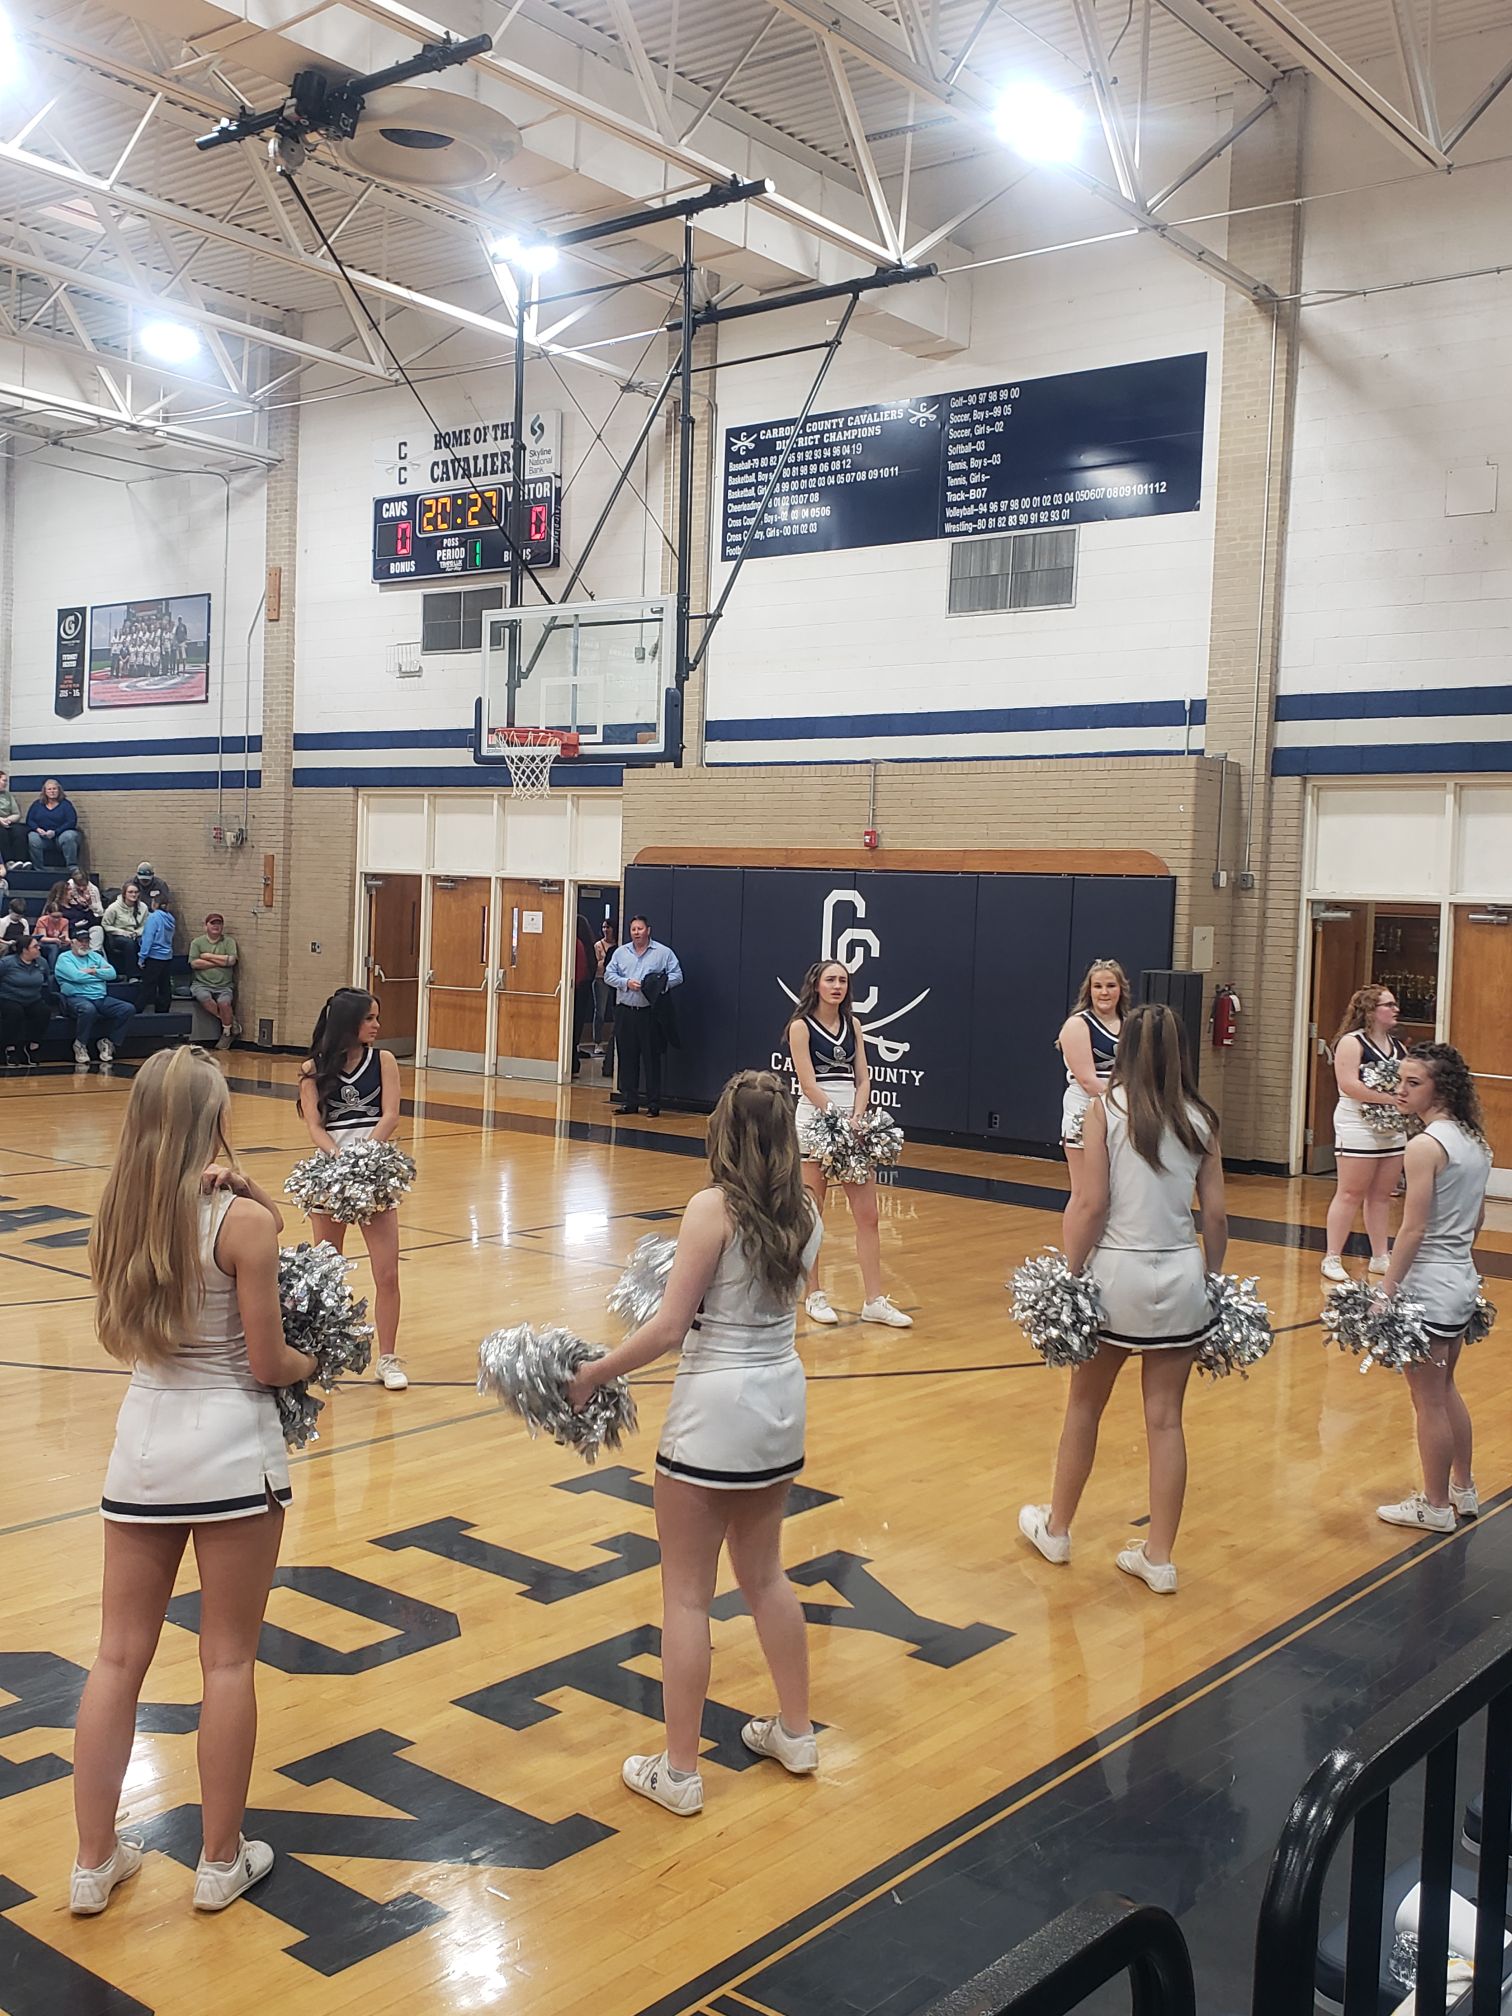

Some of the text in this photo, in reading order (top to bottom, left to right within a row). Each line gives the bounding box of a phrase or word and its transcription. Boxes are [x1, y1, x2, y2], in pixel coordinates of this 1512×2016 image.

[978, 392, 987, 404] 97
[999, 389, 1009, 400] 99
[1010, 387, 1020, 399] 00
[1003, 404, 1012, 415] 05
[760, 408, 904, 439] CARRO COUNTY CAVALIERS
[433, 428, 470, 451] HOME
[473, 425, 488, 443] OF
[775, 425, 882, 450] DIRICT CHAMPIONS
[528, 448, 552, 459] Skyline
[760, 457, 768, 467] 80
[769, 455, 777, 466] 82
[804, 450, 813, 461] 92
[823, 447, 831, 458] 94
[842, 445, 850, 455] 04
[851, 442, 863, 455] 19
[430, 450, 513, 484] CAVALIER
[782, 467, 790, 478] 80
[809, 463, 817, 475] 99
[819, 462, 829, 473] 06
[841, 458, 851, 469] 12
[506, 481, 551, 502] VITOR
[781, 481, 790, 493] 99
[790, 480, 799, 491] 00
[800, 479, 808, 489] 01
[808, 478, 817, 488] 02
[817, 477, 826, 488] 03
[826, 475, 835, 486] 04
[836, 474, 844, 485] 05
[809, 492, 819, 503] 08
[999, 500, 1009, 511] 97
[1020, 497, 1031, 509] 00
[1032, 496, 1040, 508] 01
[1042, 495, 1051, 506] 02
[1053, 493, 1062, 505] 03
[1064, 492, 1074, 504] 04
[382, 500, 408, 519] CAVS
[423, 490, 497, 531] 20:27
[1007, 515, 1017, 526] 83
[1018, 513, 1029, 525] 90
[1029, 512, 1038, 524] 91
[1039, 511, 1049, 522] 92
[1050, 509, 1060, 521] 93
[1061, 508, 1070, 520] 01
[530, 505, 547, 541] 0
[800, 523, 808, 534] 02
[808, 522, 817, 533] 03
[396, 521, 412, 555] 0
[442, 537, 459, 547] POSS
[436, 547, 465, 561] PERIOD
[390, 560, 416, 574] BONUS
[866, 1066, 925, 1086] OUNTY
